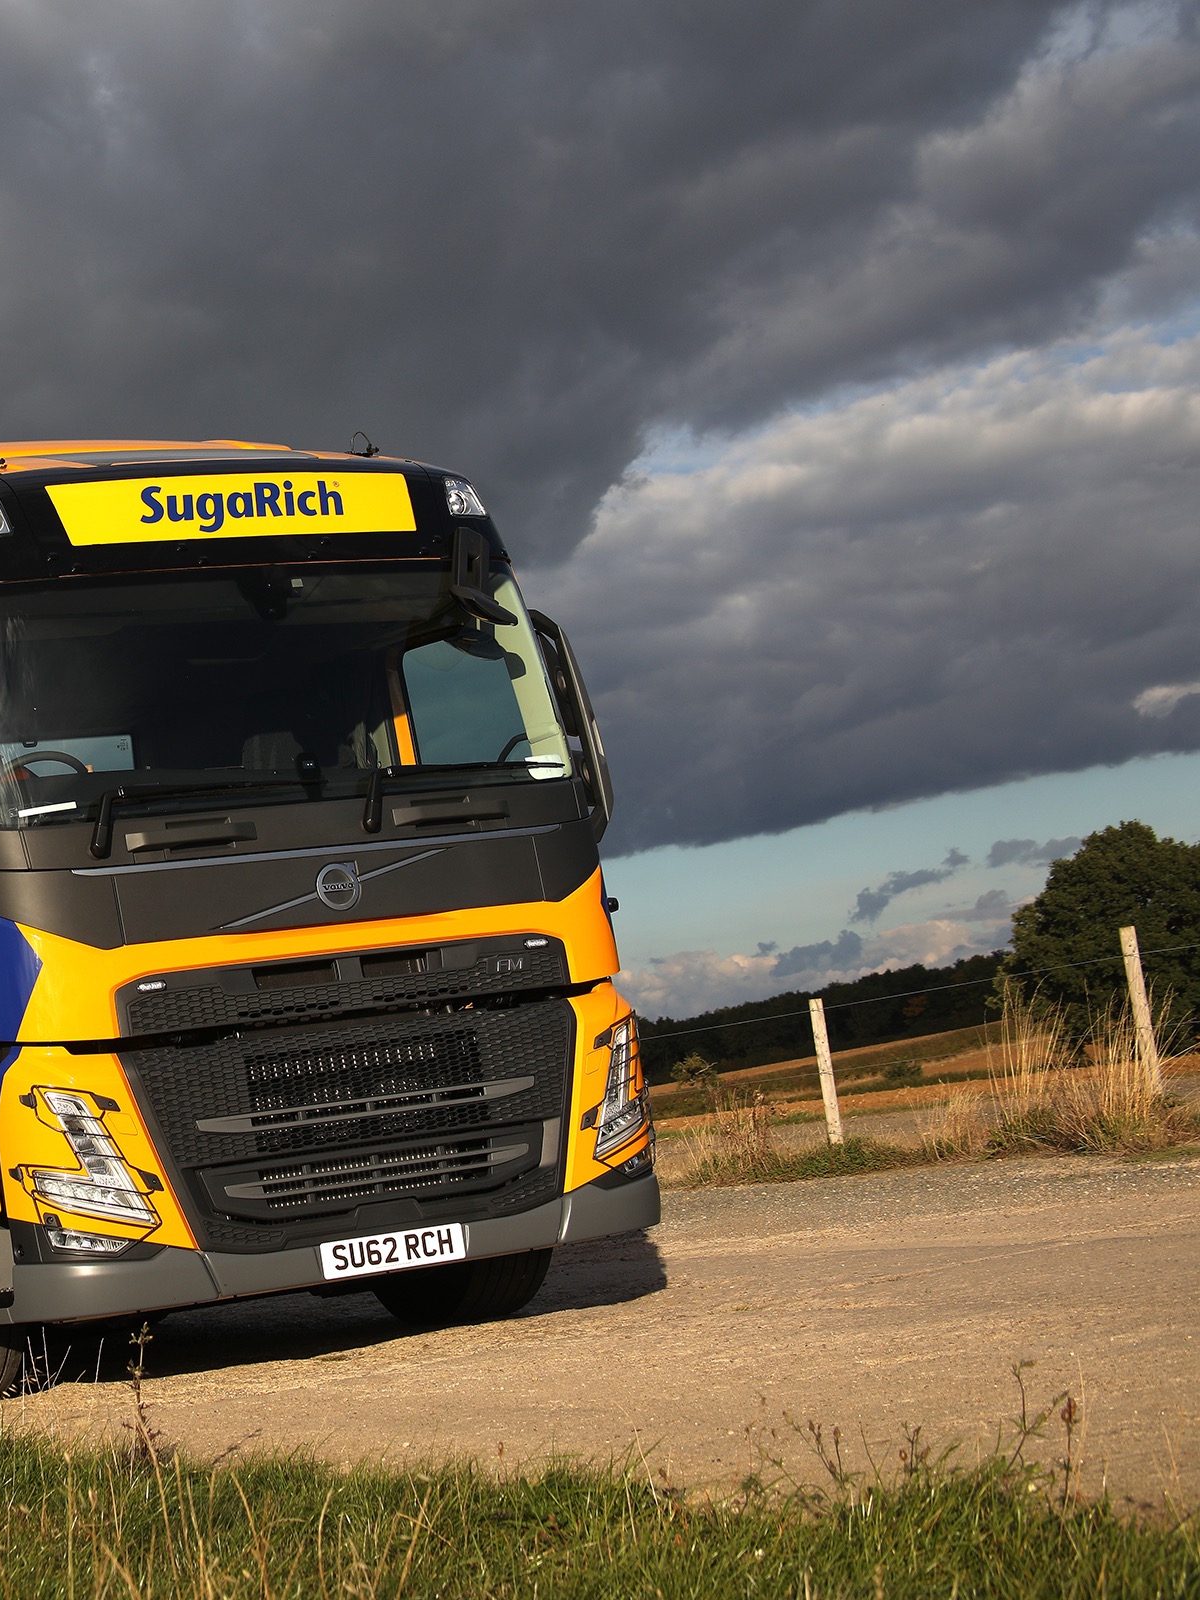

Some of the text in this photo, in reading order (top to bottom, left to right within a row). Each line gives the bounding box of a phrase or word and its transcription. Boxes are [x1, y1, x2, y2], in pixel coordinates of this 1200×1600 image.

[140, 480, 344, 533] SugaRich
[322, 882, 355, 891] VOLVO
[497, 958, 523, 972] FM
[332, 1228, 454, 1271] SU62 RCH
